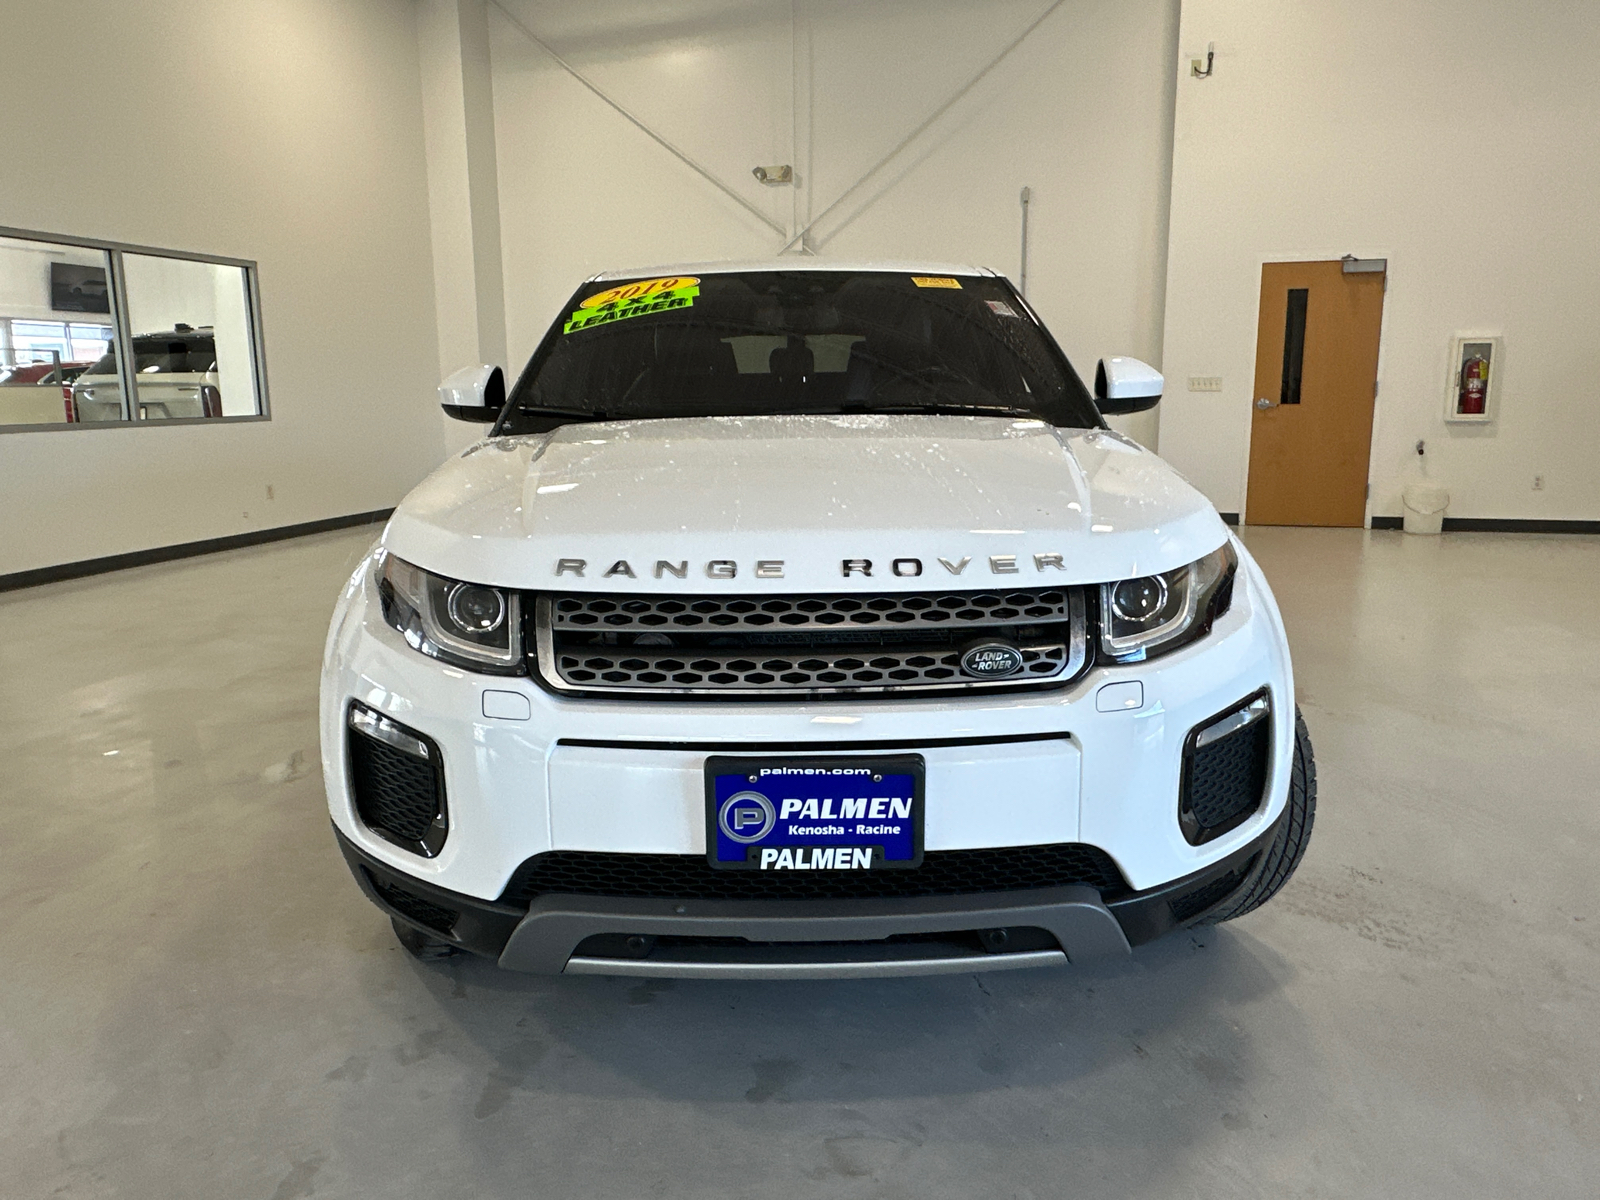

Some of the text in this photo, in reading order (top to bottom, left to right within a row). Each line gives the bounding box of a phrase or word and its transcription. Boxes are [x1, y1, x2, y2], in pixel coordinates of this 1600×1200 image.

[599, 278, 679, 305] 2019
[568, 297, 689, 332] LEATHER
[555, 552, 1069, 580] RANGE ROVER
[975, 651, 1003, 662] LAND
[977, 660, 1012, 671] ROVER
[759, 766, 872, 777] palmen.com
[779, 797, 913, 820] PALMEN
[788, 824, 845, 836] Kenosha
[855, 824, 901, 836] Racine
[760, 847, 873, 870] PALMEN
